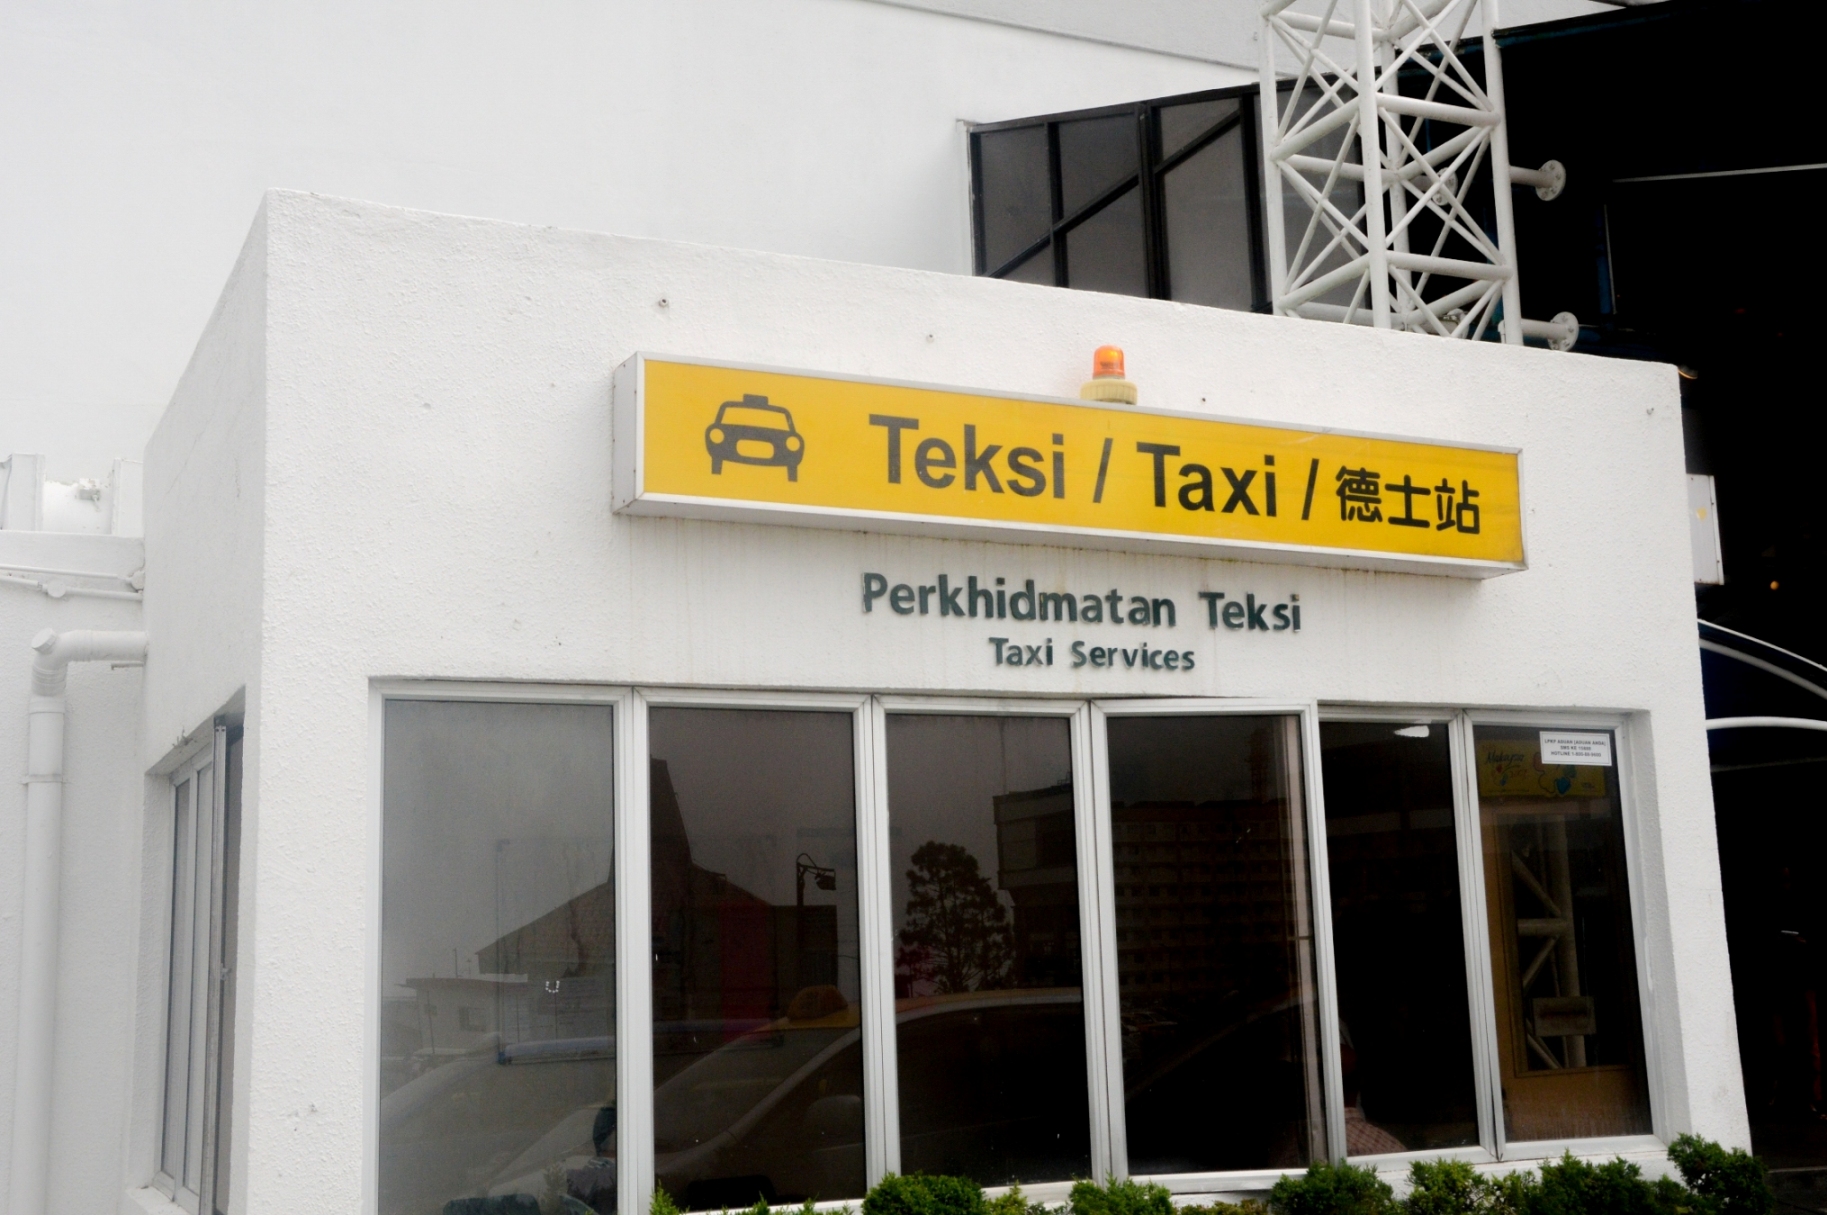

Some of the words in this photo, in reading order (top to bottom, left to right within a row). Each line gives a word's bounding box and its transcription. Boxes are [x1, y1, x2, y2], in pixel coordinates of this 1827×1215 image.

[869, 414, 1065, 500] Teksi
[1136, 442, 1277, 518] Taxi
[1335, 465, 1481, 535] 德士站
[862, 572, 1177, 628] Perkhidmatan
[1198, 590, 1301, 633] Teksi
[988, 637, 1053, 668] Taxi
[1071, 640, 1195, 672] Services
